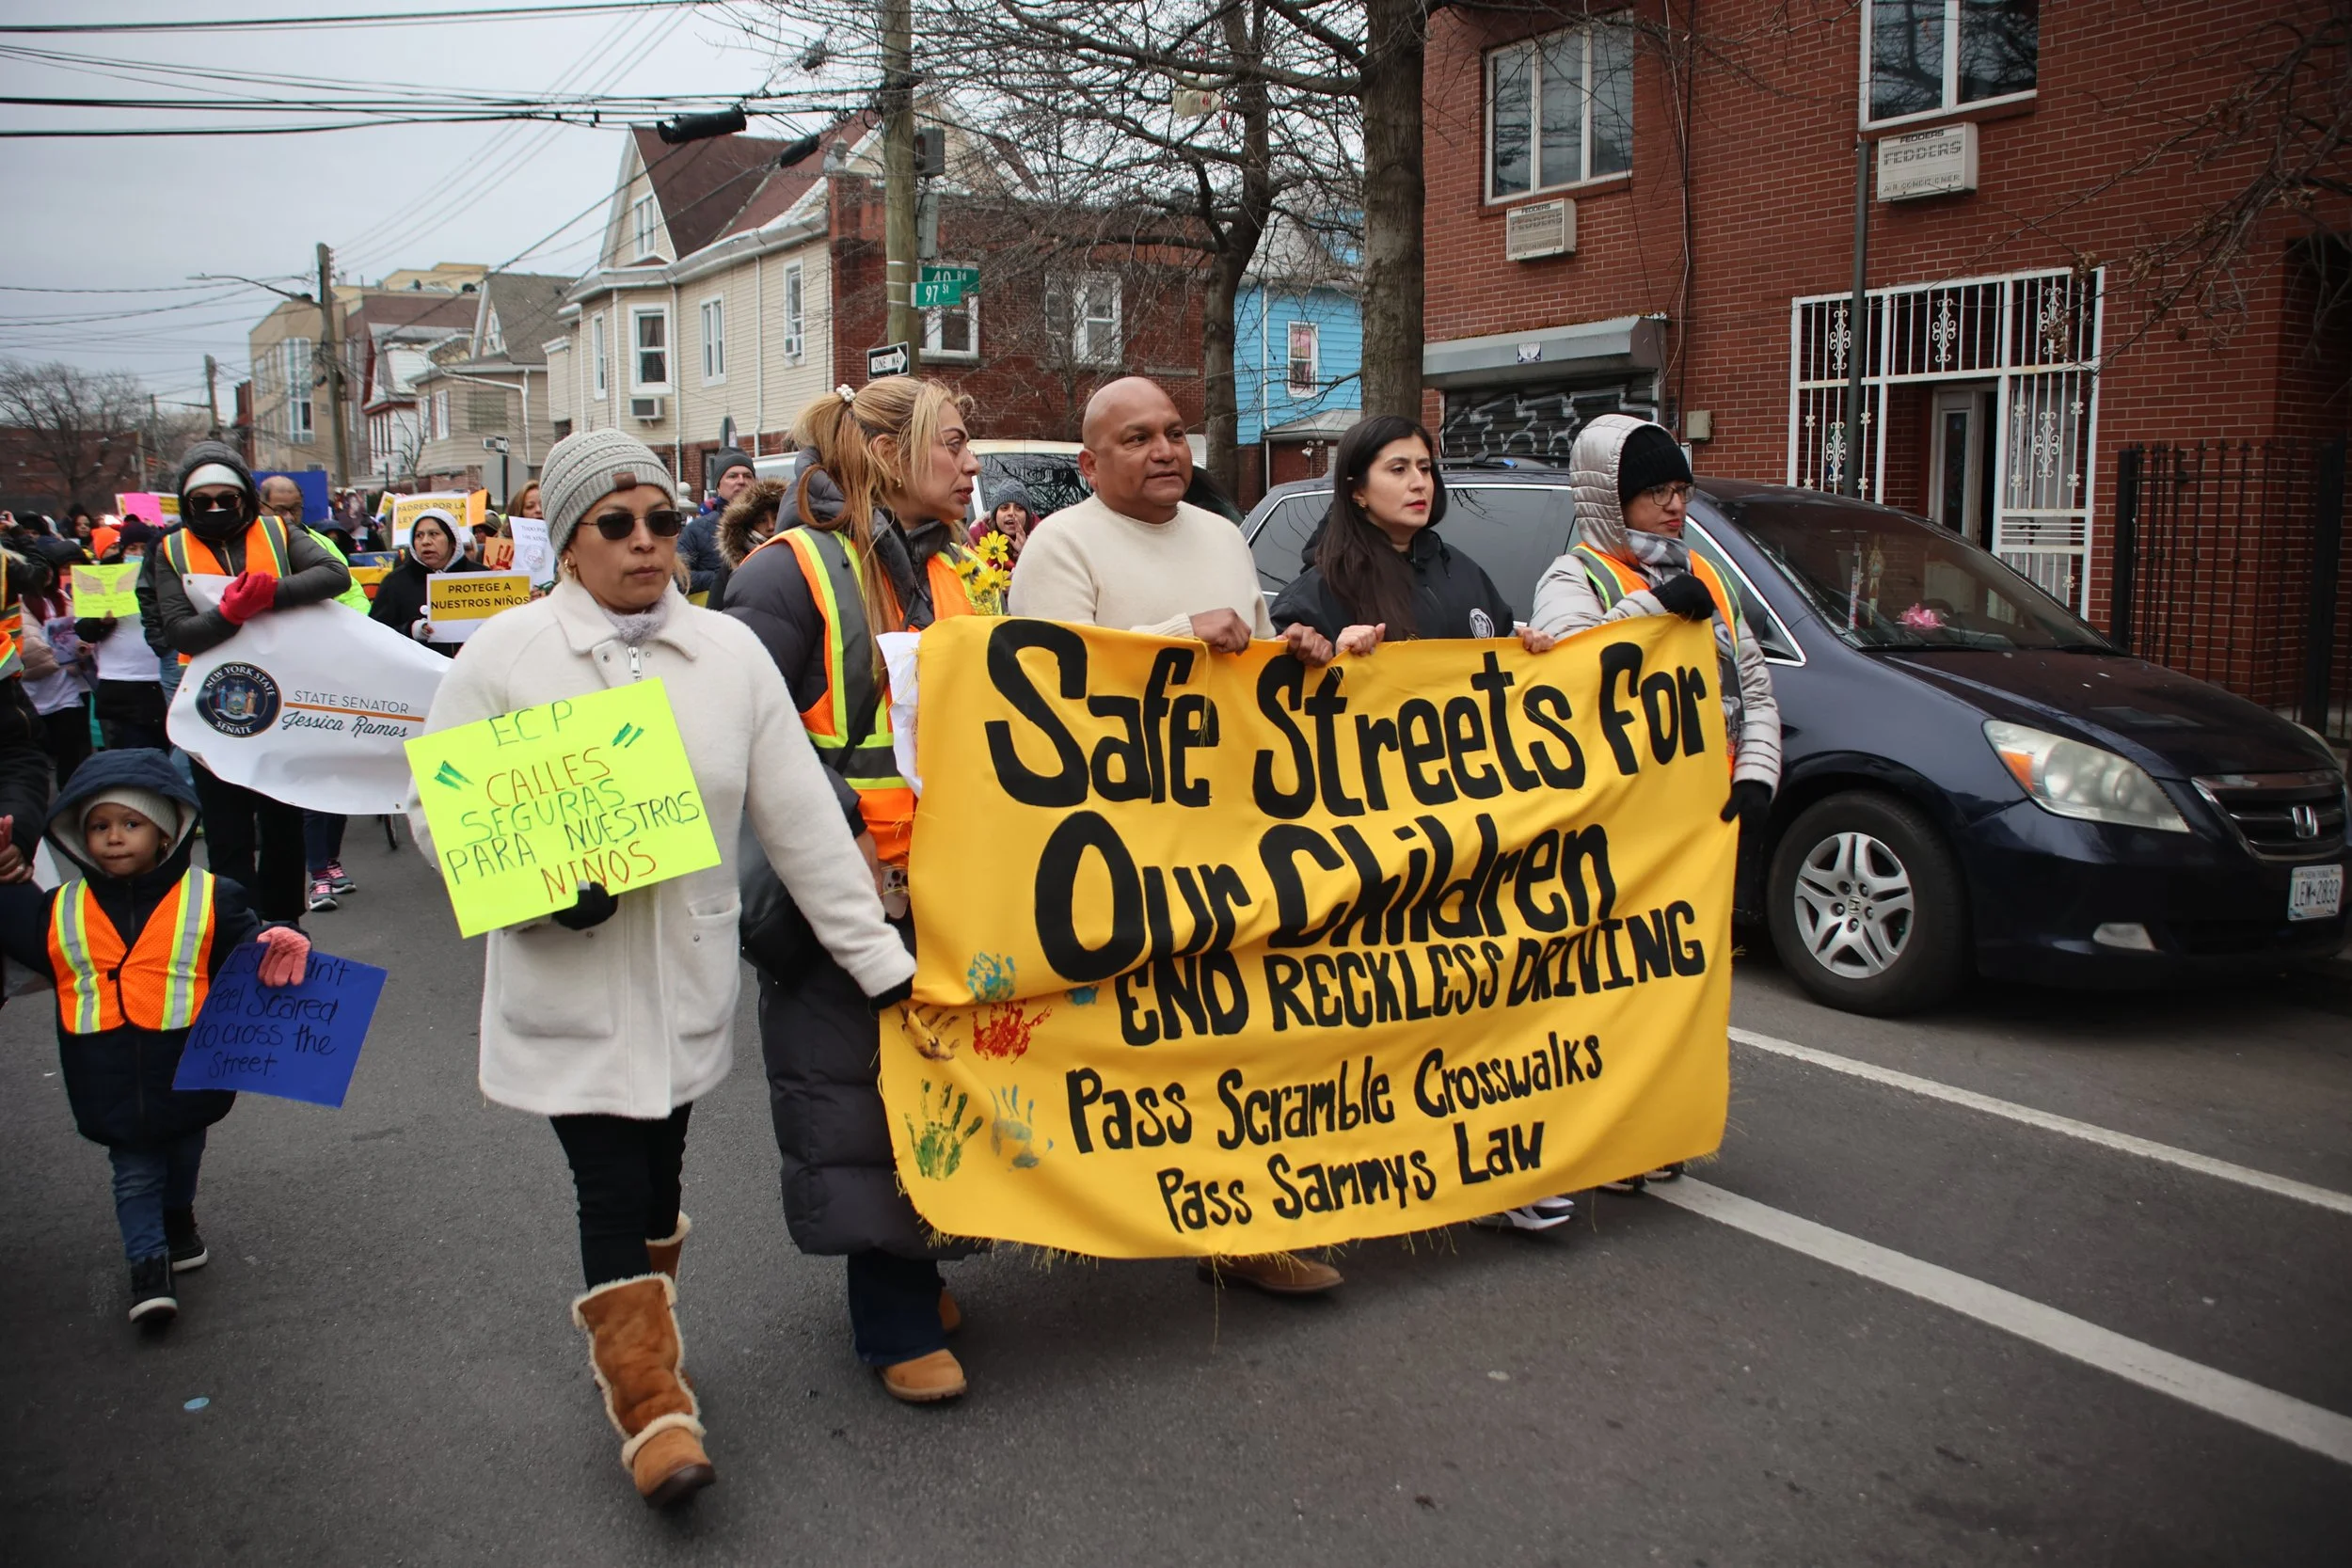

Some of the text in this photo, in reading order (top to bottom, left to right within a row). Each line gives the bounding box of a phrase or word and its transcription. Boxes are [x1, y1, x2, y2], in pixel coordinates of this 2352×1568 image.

[1900, 129, 1945, 143] FEDDERS
[1883, 140, 1962, 166] FEDDERS
[1521, 203, 1550, 214] FEDDERS
[932, 271, 967, 282] 40 Rd
[926, 284, 949, 303] 97 St
[874, 355, 903, 371] ONE WAY
[397, 502, 430, 513] PADRES
[398, 515, 413, 524] LEY
[449, 582, 512, 594] PROTEGE A
[431, 595, 530, 610] NUESTROS NIÑOS
[206, 664, 277, 698] NEW YORK STATE
[294, 689, 409, 715] STATE SENATOR
[215, 720, 253, 736] SENATE
[282, 711, 408, 738] Jessica Ramos
[985, 619, 1220, 807] Safe
[1252, 651, 1586, 819] Streets
[486, 746, 611, 807] CALLES
[461, 778, 626, 847] SEGURAS
[446, 790, 700, 885] PARA NUESTROS
[541, 840, 657, 904] NIÑOS
[1035, 810, 1617, 982] Our Children
[1115, 899, 1706, 1047] END RECKLESS DRIVING
[206, 979, 244, 1016] feel
[194, 1021, 218, 1050] to
[292, 1023, 337, 1056] the
[1066, 1031, 1603, 1155] Pass Scramble Crosswalks
[1157, 1121, 1546, 1234] Pass Sammys Law
